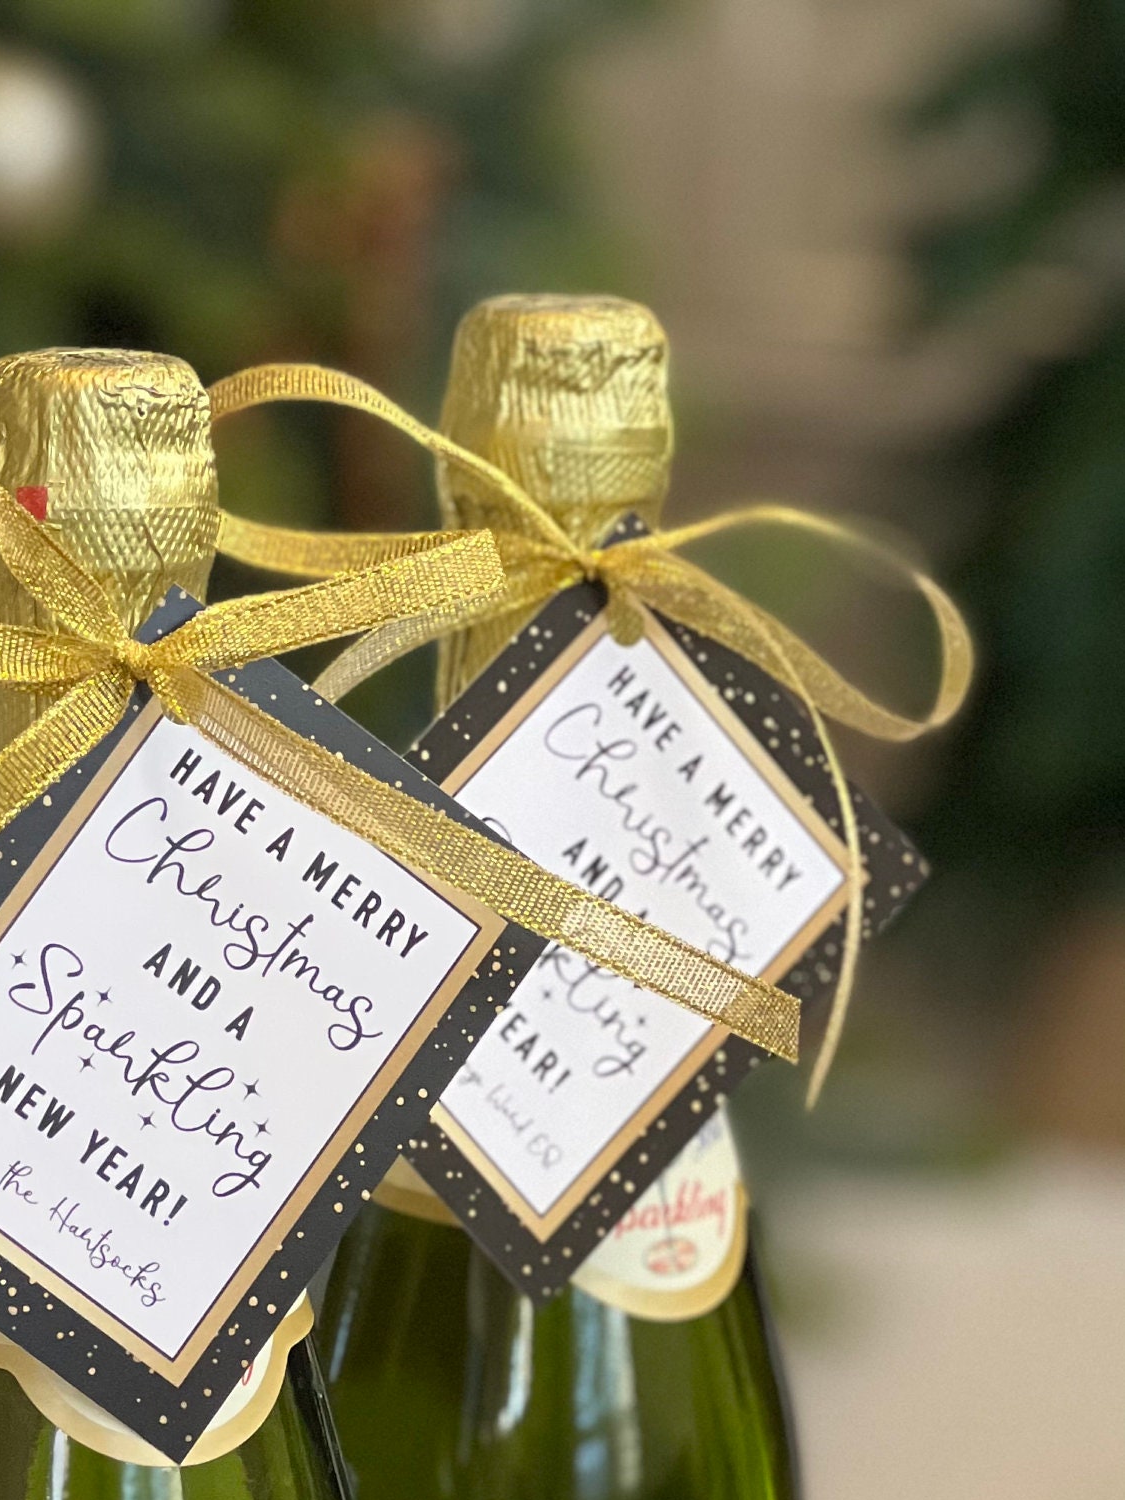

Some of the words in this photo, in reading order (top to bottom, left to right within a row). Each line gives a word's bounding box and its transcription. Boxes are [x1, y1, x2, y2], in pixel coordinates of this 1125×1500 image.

[171, 749, 265, 834] HAVE
[266, 827, 293, 862] A
[303, 851, 429, 957] MERRY
[544, 704, 759, 962] Christmas
[608, 666, 681, 751] HAVE
[679, 755, 701, 781] A
[706, 783, 806, 892] MERRY
[105, 799, 382, 1050] Christmas
[562, 838, 625, 901] AND
[9, 944, 273, 1196] Sparkling
[143, 943, 223, 1011] AND
[225, 1007, 253, 1041] A
[499, 1008, 572, 1094] EAR!
[49, 1196, 166, 1307] Hartsocks
[80, 1129, 188, 1227] YEAR!
